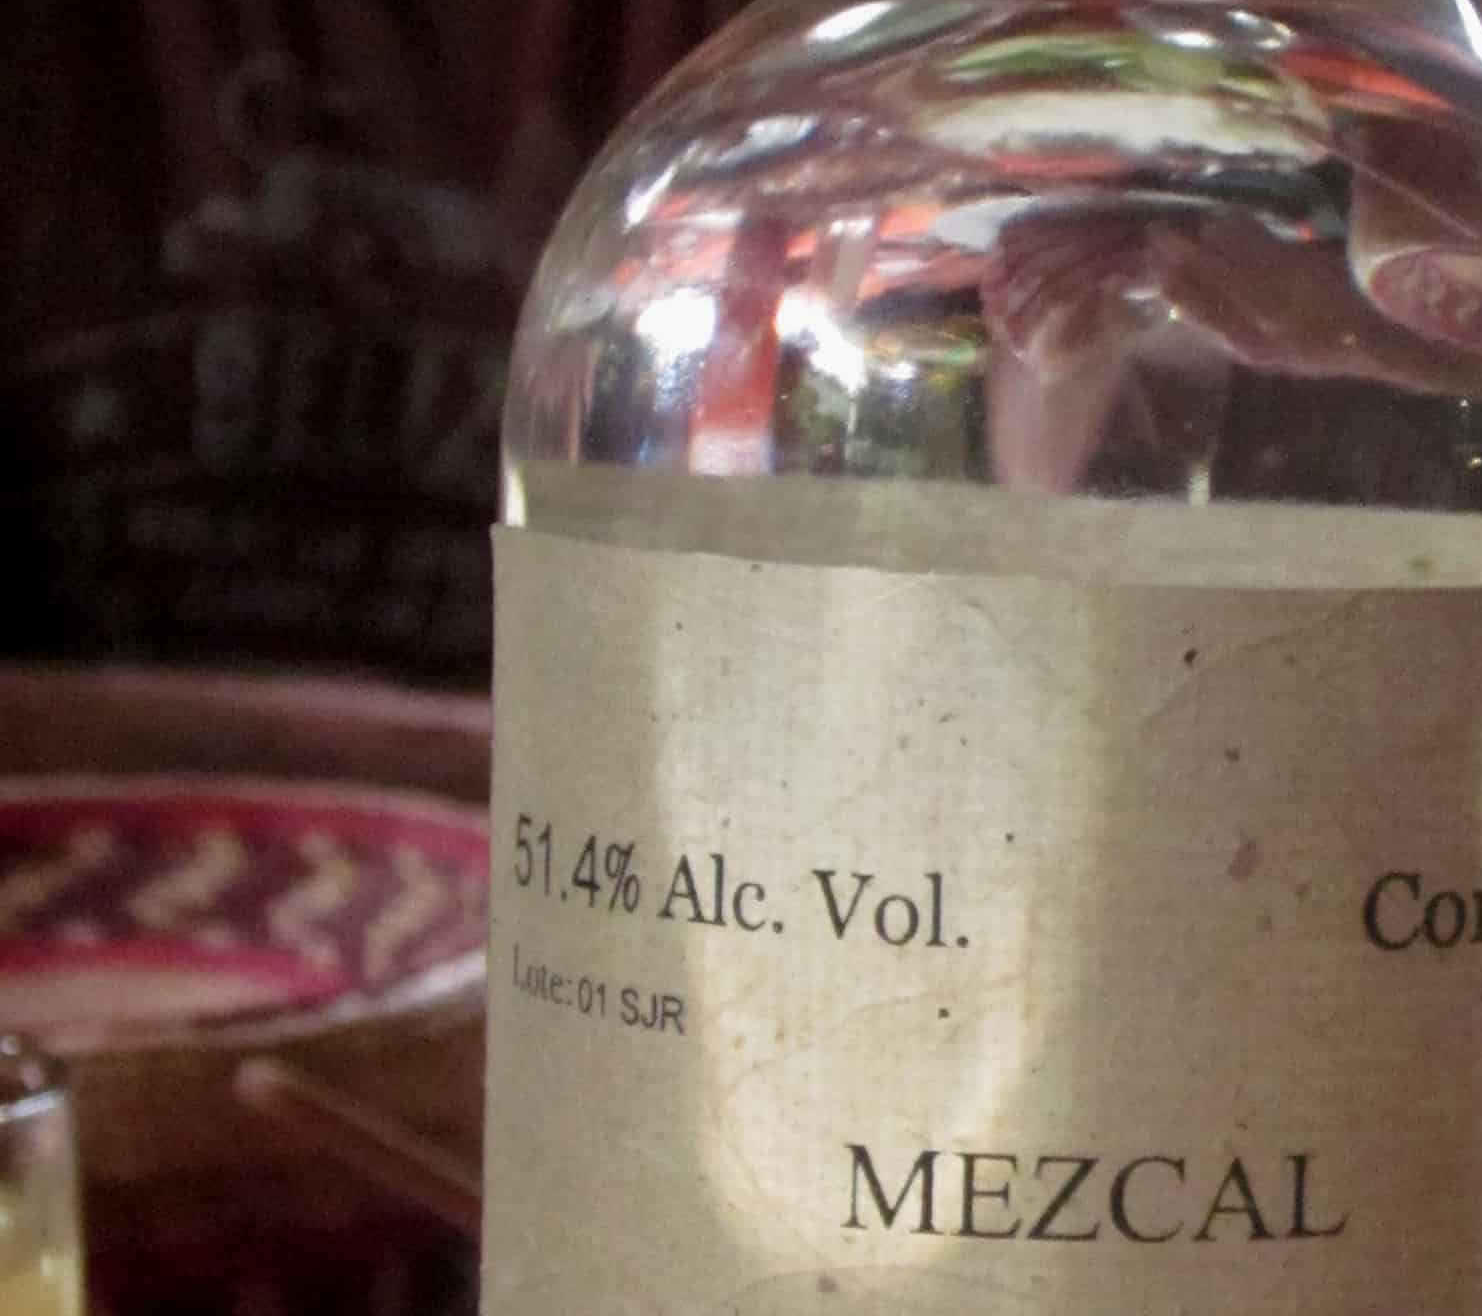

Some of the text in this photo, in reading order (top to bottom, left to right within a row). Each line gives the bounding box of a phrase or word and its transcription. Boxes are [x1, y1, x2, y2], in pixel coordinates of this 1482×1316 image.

[514, 812, 970, 949] 51.4% Alc. Vol.
[619, 987, 689, 1037] SJR
[841, 1142, 1352, 1244] MEZCAL
